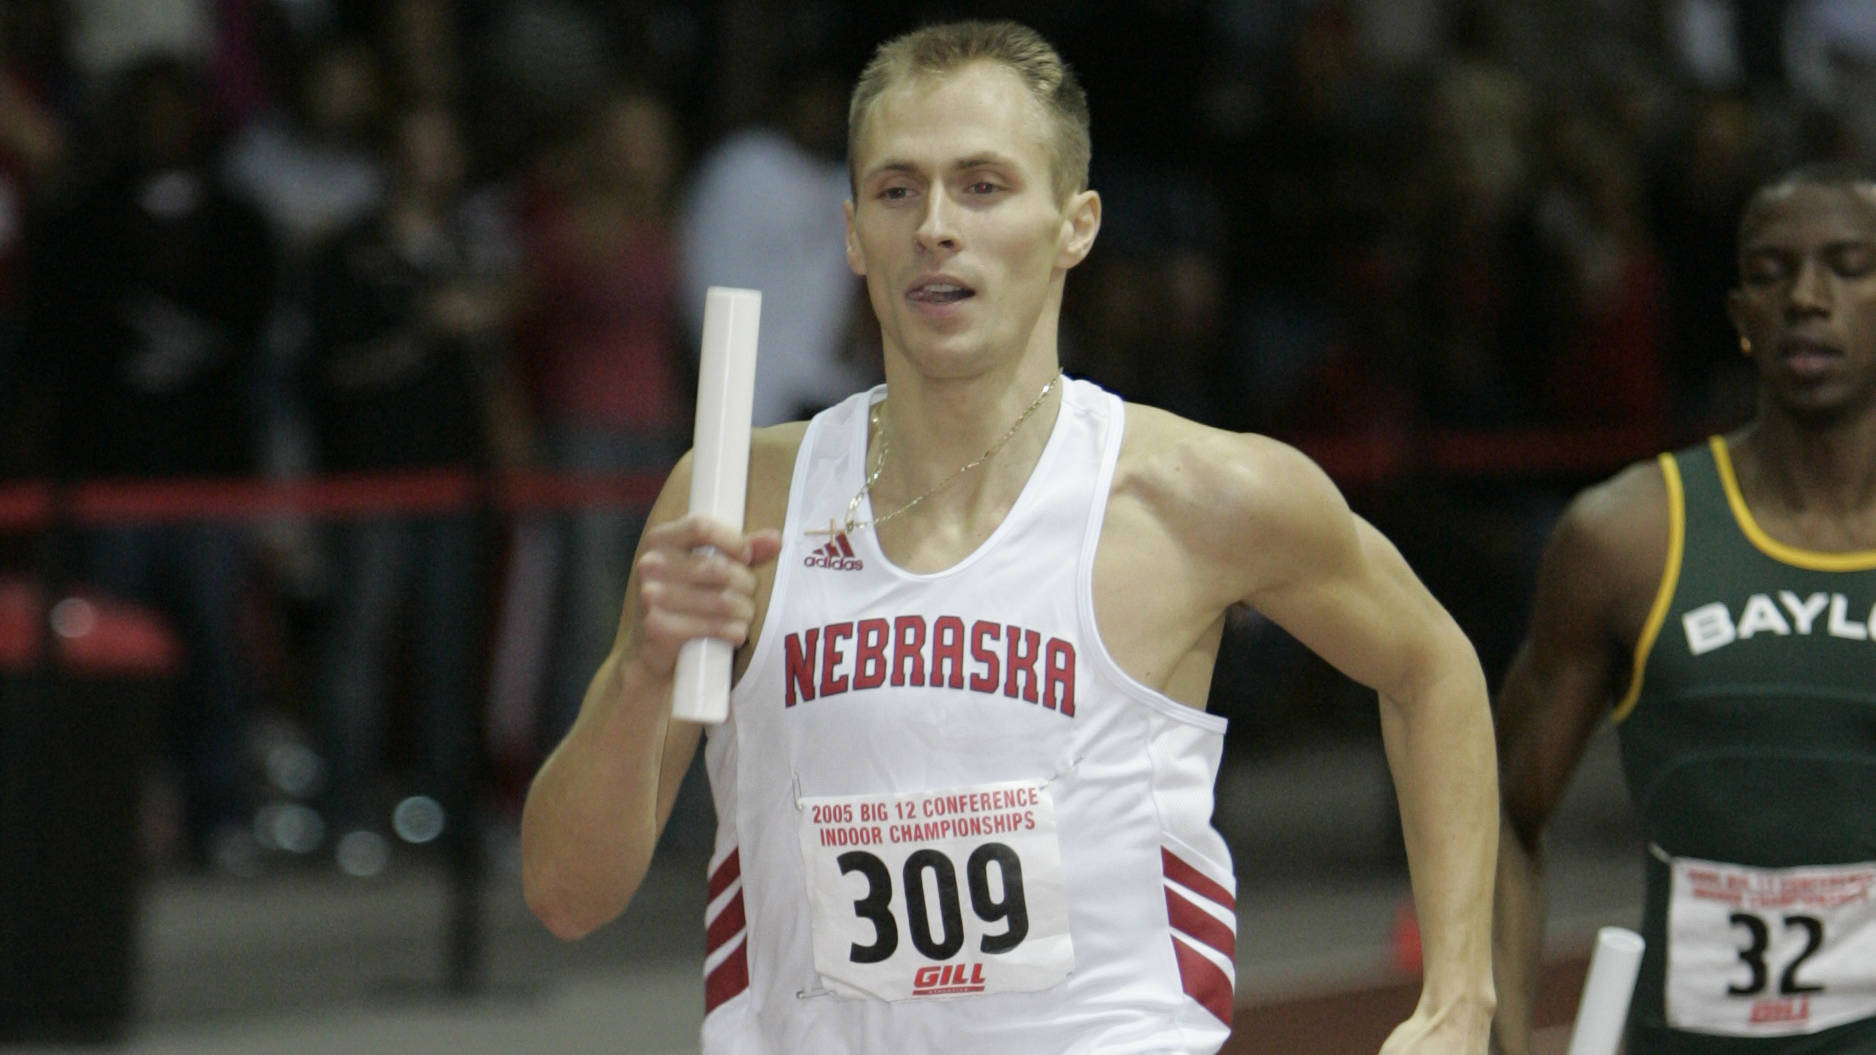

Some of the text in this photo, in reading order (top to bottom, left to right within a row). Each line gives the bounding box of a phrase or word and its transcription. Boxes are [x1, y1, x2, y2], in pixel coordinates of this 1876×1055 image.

[804, 556, 864, 571] adidas
[784, 614, 1076, 718] NEBRASKA
[812, 787, 1039, 824] 2005 BIG 12 CONFERENCE
[820, 811, 1036, 847] INDOOR CHAMPIONSHIPS
[836, 842, 1029, 964] 309
[1727, 912, 1824, 995] 32
[913, 963, 986, 988] GILL
